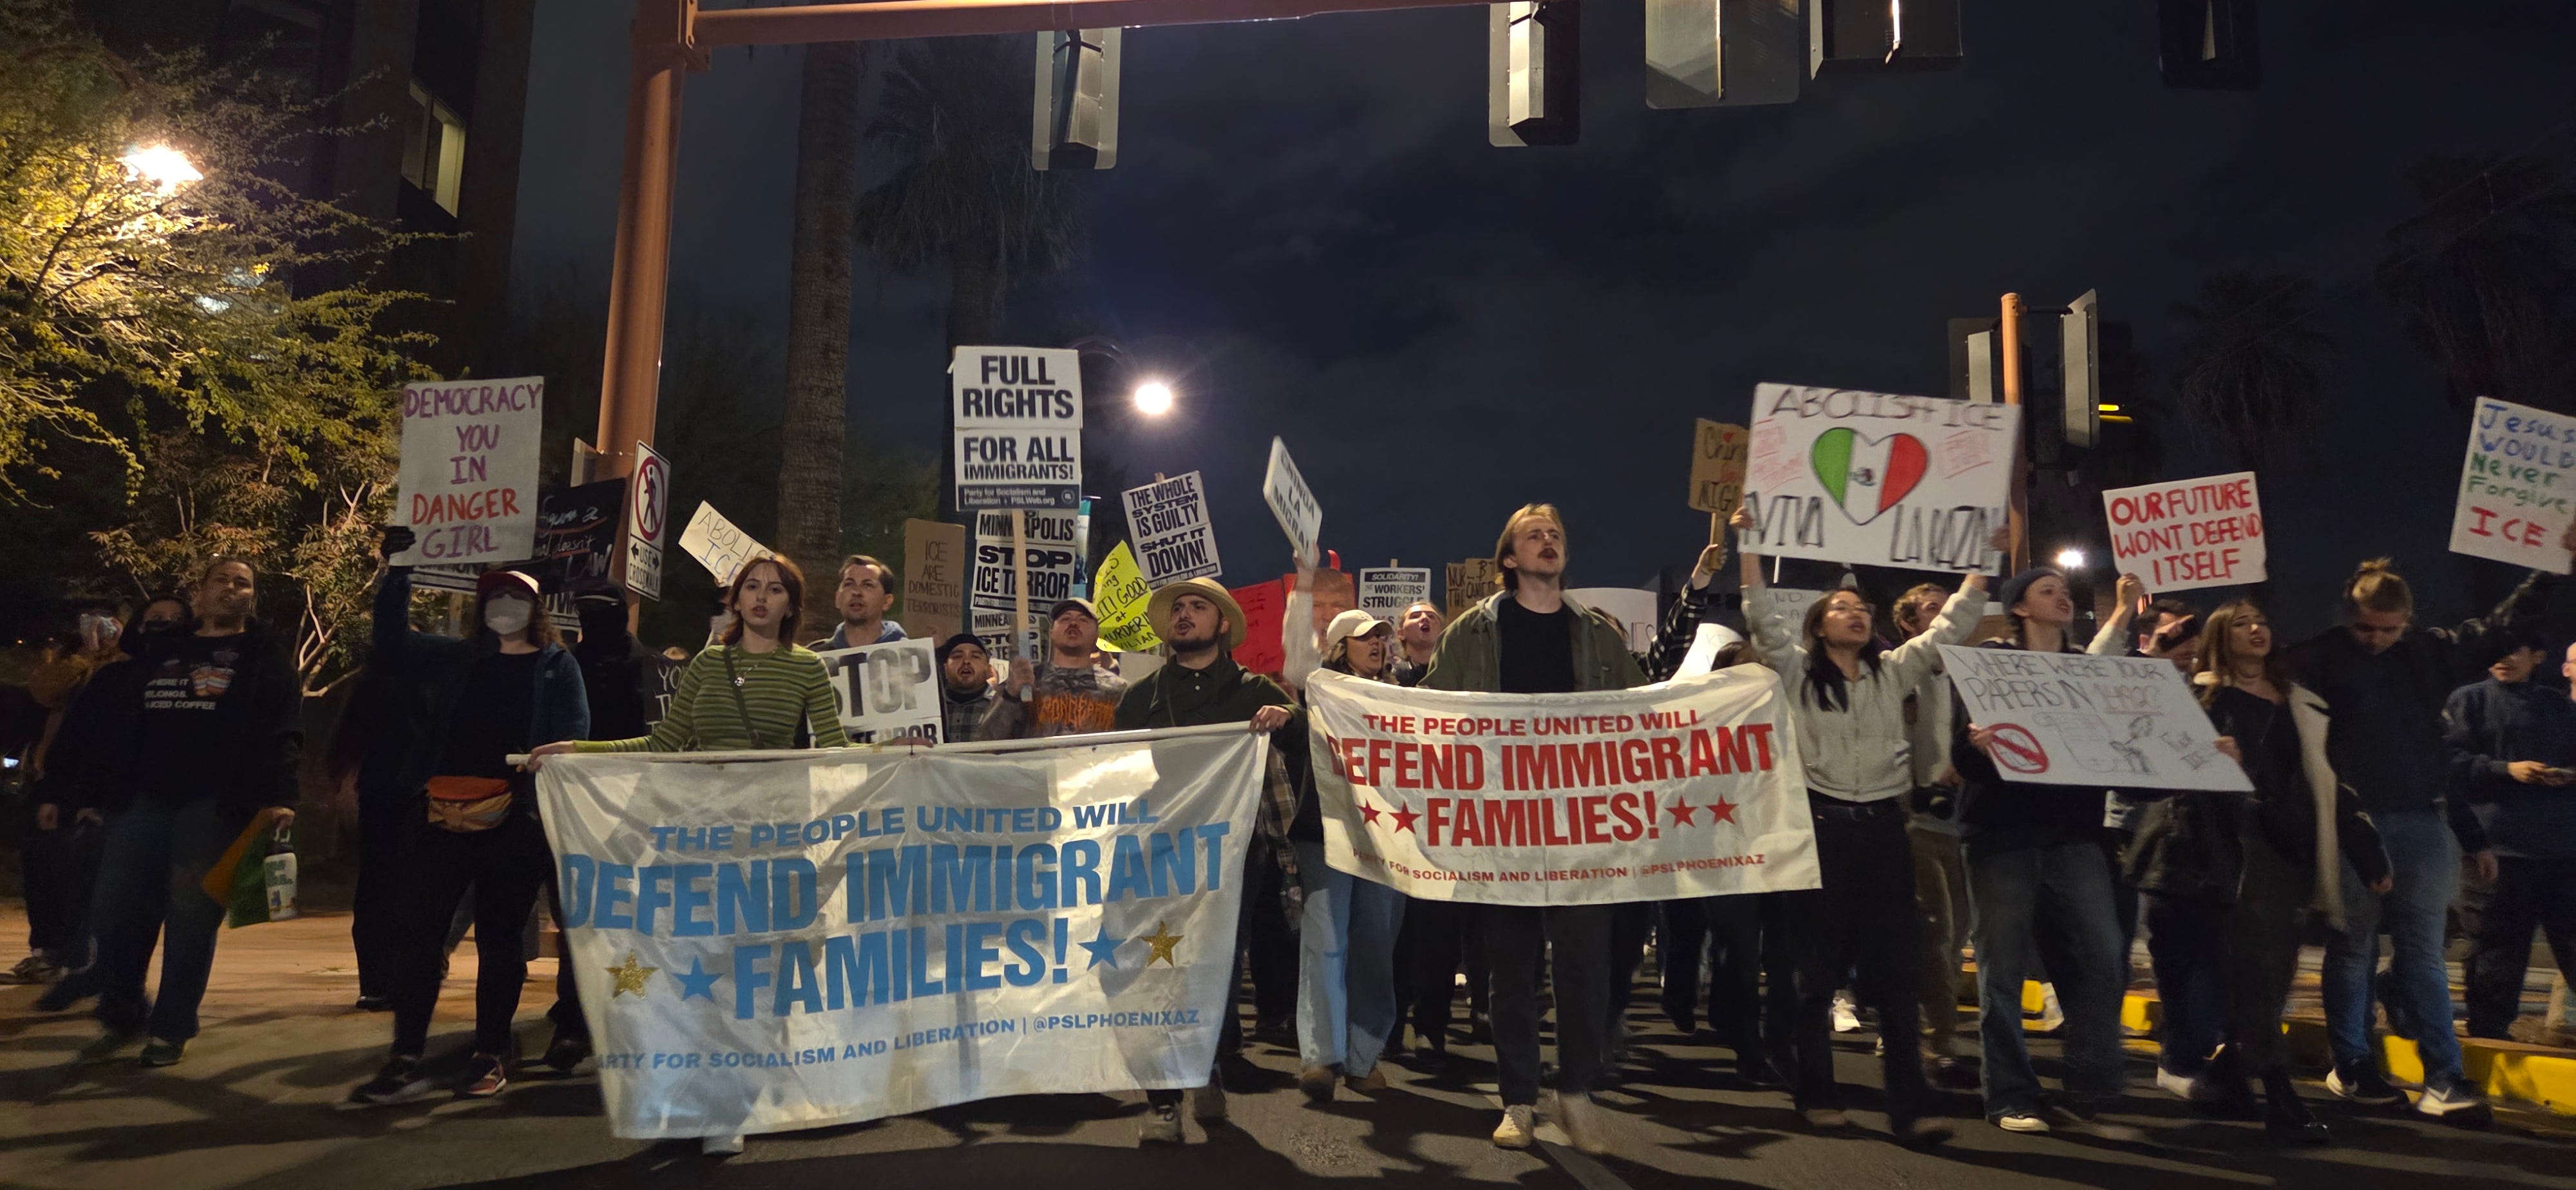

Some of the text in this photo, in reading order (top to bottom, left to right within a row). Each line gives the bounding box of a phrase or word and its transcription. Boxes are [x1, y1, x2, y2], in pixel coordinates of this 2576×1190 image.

[981, 355, 1056, 385] FULL
[404, 383, 544, 418] DEMOCRACY
[962, 388, 1074, 419] RIGHTS
[1768, 388, 2004, 431] ABOLISH ICE
[456, 423, 501, 452] YOU
[2479, 403, 2575, 444] Jesus
[963, 436, 1074, 463] FOR ALL
[450, 455, 487, 484] IN
[963, 463, 1074, 480] IMMIGRANTS!
[2470, 452, 2561, 487] Never
[412, 487, 520, 525] DANGER
[1128, 475, 1196, 509] THE WHOLE
[1132, 493, 1199, 518] SYSTEM
[2110, 478, 2253, 526] OUR FUTURE
[2467, 475, 2568, 515] Forgive
[979, 513, 1074, 542] MINNAPOLIS
[1135, 502, 1200, 538] IS GUILTY
[2468, 505, 2548, 547] ICE
[421, 524, 500, 558] GIRL
[697, 511, 767, 562] ABOLI
[925, 540, 949, 562] ICE
[1139, 527, 1206, 553] SHUT IT
[2114, 513, 2262, 559] WONT DEFEND
[639, 546, 652, 568] USE
[978, 545, 1072, 569] STOP
[1146, 538, 1209, 578] DOWN!
[2152, 547, 2240, 586] ITSELF
[629, 562, 659, 592] CROSSWALK
[922, 564, 945, 582] ARE
[975, 565, 999, 593] ICE
[908, 580, 960, 598] DOMESTIC
[1116, 576, 1148, 605] GOOD
[1374, 584, 1425, 594] WORKERS'
[905, 598, 961, 618] TERRORISTS
[1115, 611, 1126, 623] at
[657, 665, 682, 692] YO
[1947, 648, 2168, 681] WHERE WERE YOUR
[175, 700, 216, 710] COFFEE
[1964, 677, 2063, 712] PAPERS
[1361, 709, 1707, 737] THE PEOPLE UNITED WILL
[1501, 722, 1774, 792] IMMIGRANT
[650, 799, 1160, 851] THE PEOPLE UNITED WILL
[1426, 789, 1660, 848] FAMILIES!
[562, 821, 1231, 938] DEFEND IMMIGRANT
[1388, 860, 1410, 876] FOR
[1412, 869, 1495, 882] SOCIALISM
[1499, 871, 1531, 882] AND
[1534, 866, 1628, 882] LIBERATION
[1640, 853, 1765, 876] @PSLPHOENIXAZ
[734, 918, 1068, 1021] FAMILIES!
[594, 1053, 645, 1070] ARTY
[652, 1052, 700, 1070] FOR
[707, 1046, 835, 1069] SOCIALISM
[842, 1040, 887, 1060] AND
[894, 1018, 1016, 1050] LIBERATION
[1032, 1009, 1200, 1032] @PSLPHOENIXAZ
